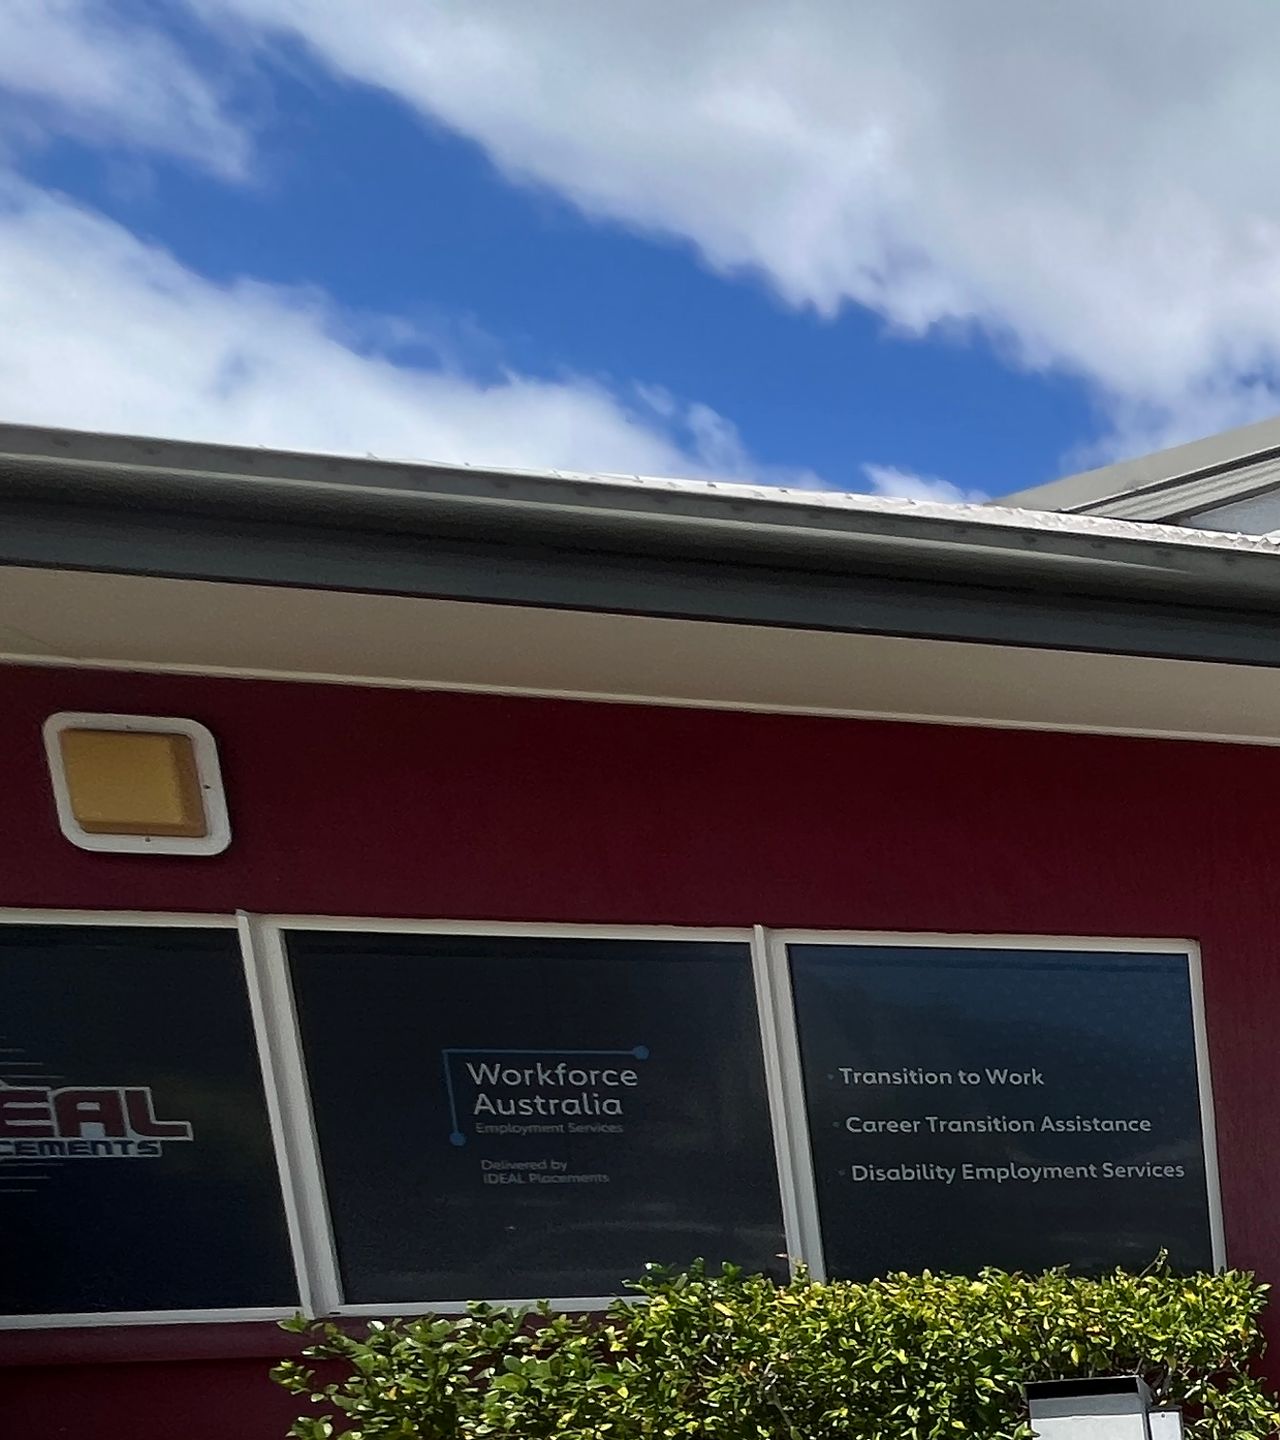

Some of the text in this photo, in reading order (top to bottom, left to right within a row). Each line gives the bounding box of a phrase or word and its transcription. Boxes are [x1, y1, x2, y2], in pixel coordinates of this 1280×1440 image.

[465, 1061, 639, 1087] Workforce
[838, 1067, 1045, 1086] Transition to Work
[0, 1086, 189, 1140] EAL
[473, 1092, 624, 1116] Australia
[475, 1121, 624, 1136] Employment Services
[845, 1115, 1152, 1134] Career Transition Assistance
[480, 1159, 568, 1172] Delivered by
[851, 1160, 1186, 1184] Disability Employment Services
[483, 1172, 611, 1185] IDEAL Placements
